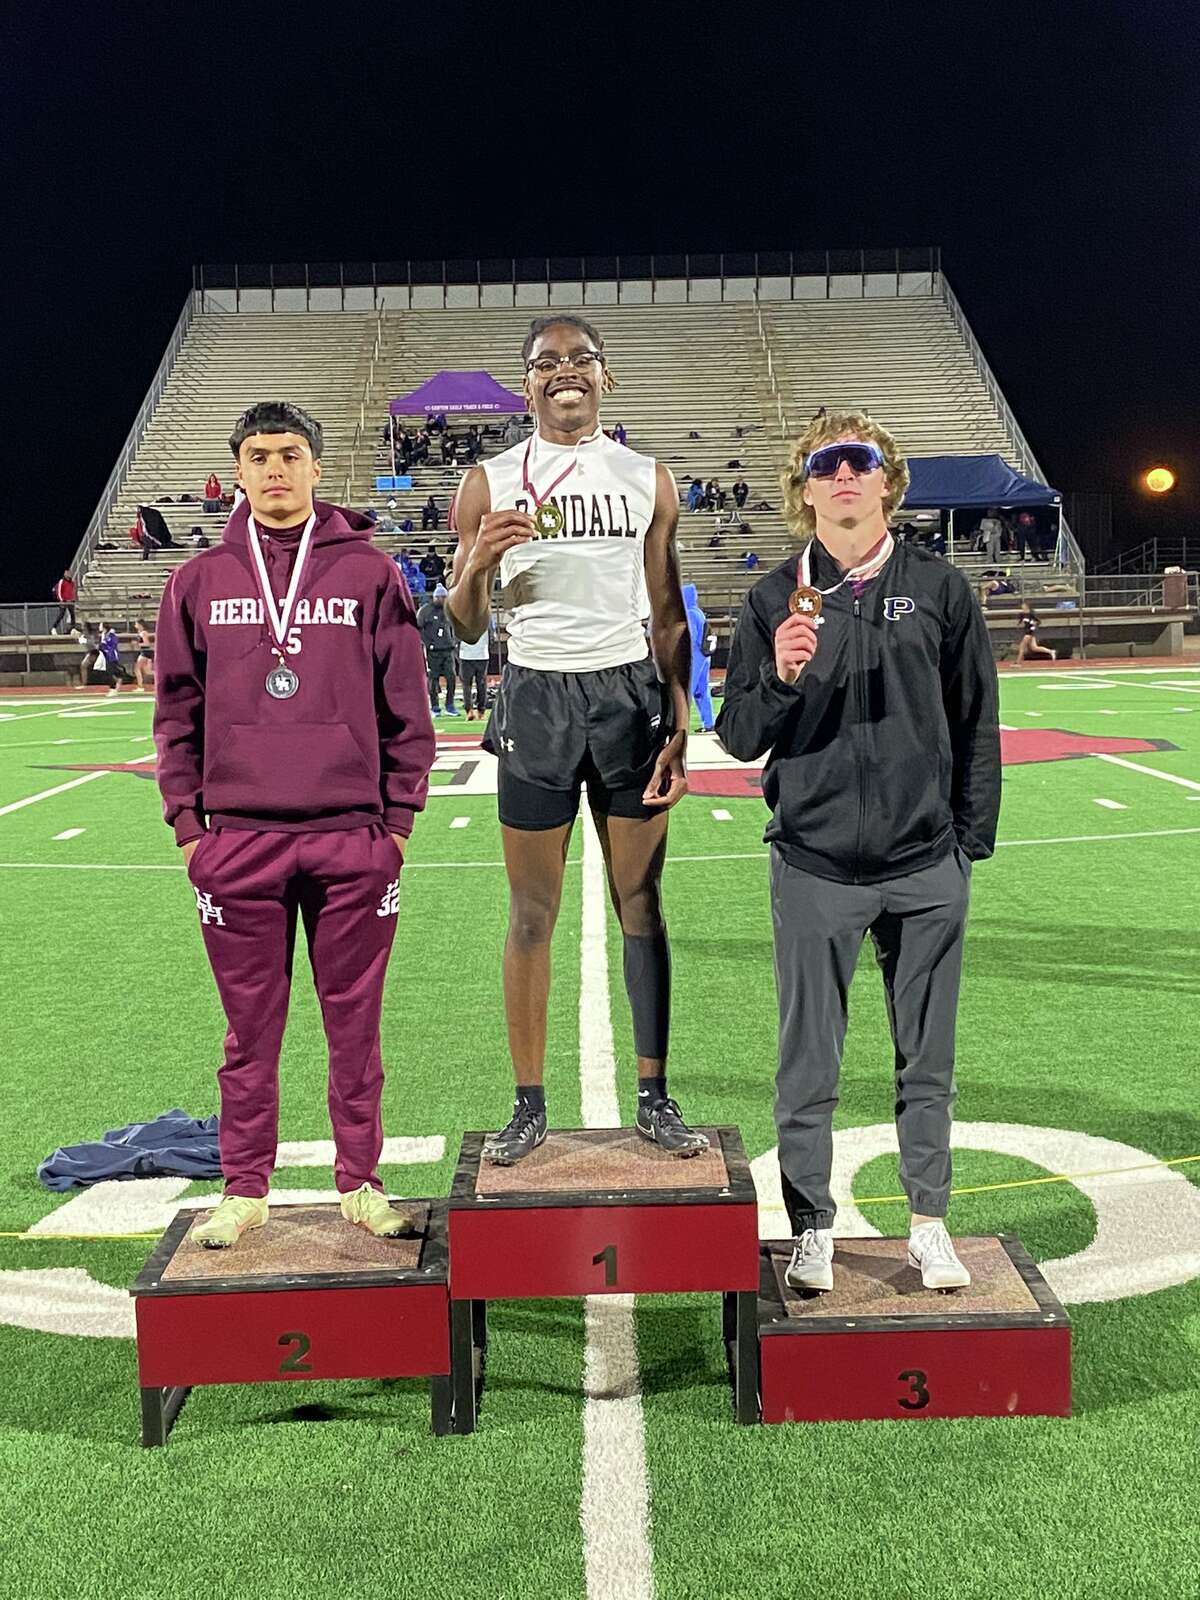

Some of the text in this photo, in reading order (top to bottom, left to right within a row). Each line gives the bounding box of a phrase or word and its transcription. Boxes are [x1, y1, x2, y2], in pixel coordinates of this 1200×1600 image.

[883, 596, 915, 621] P
[592, 1245, 617, 1286] 1
[278, 1332, 313, 1374] 2
[897, 1369, 930, 1410] 3
